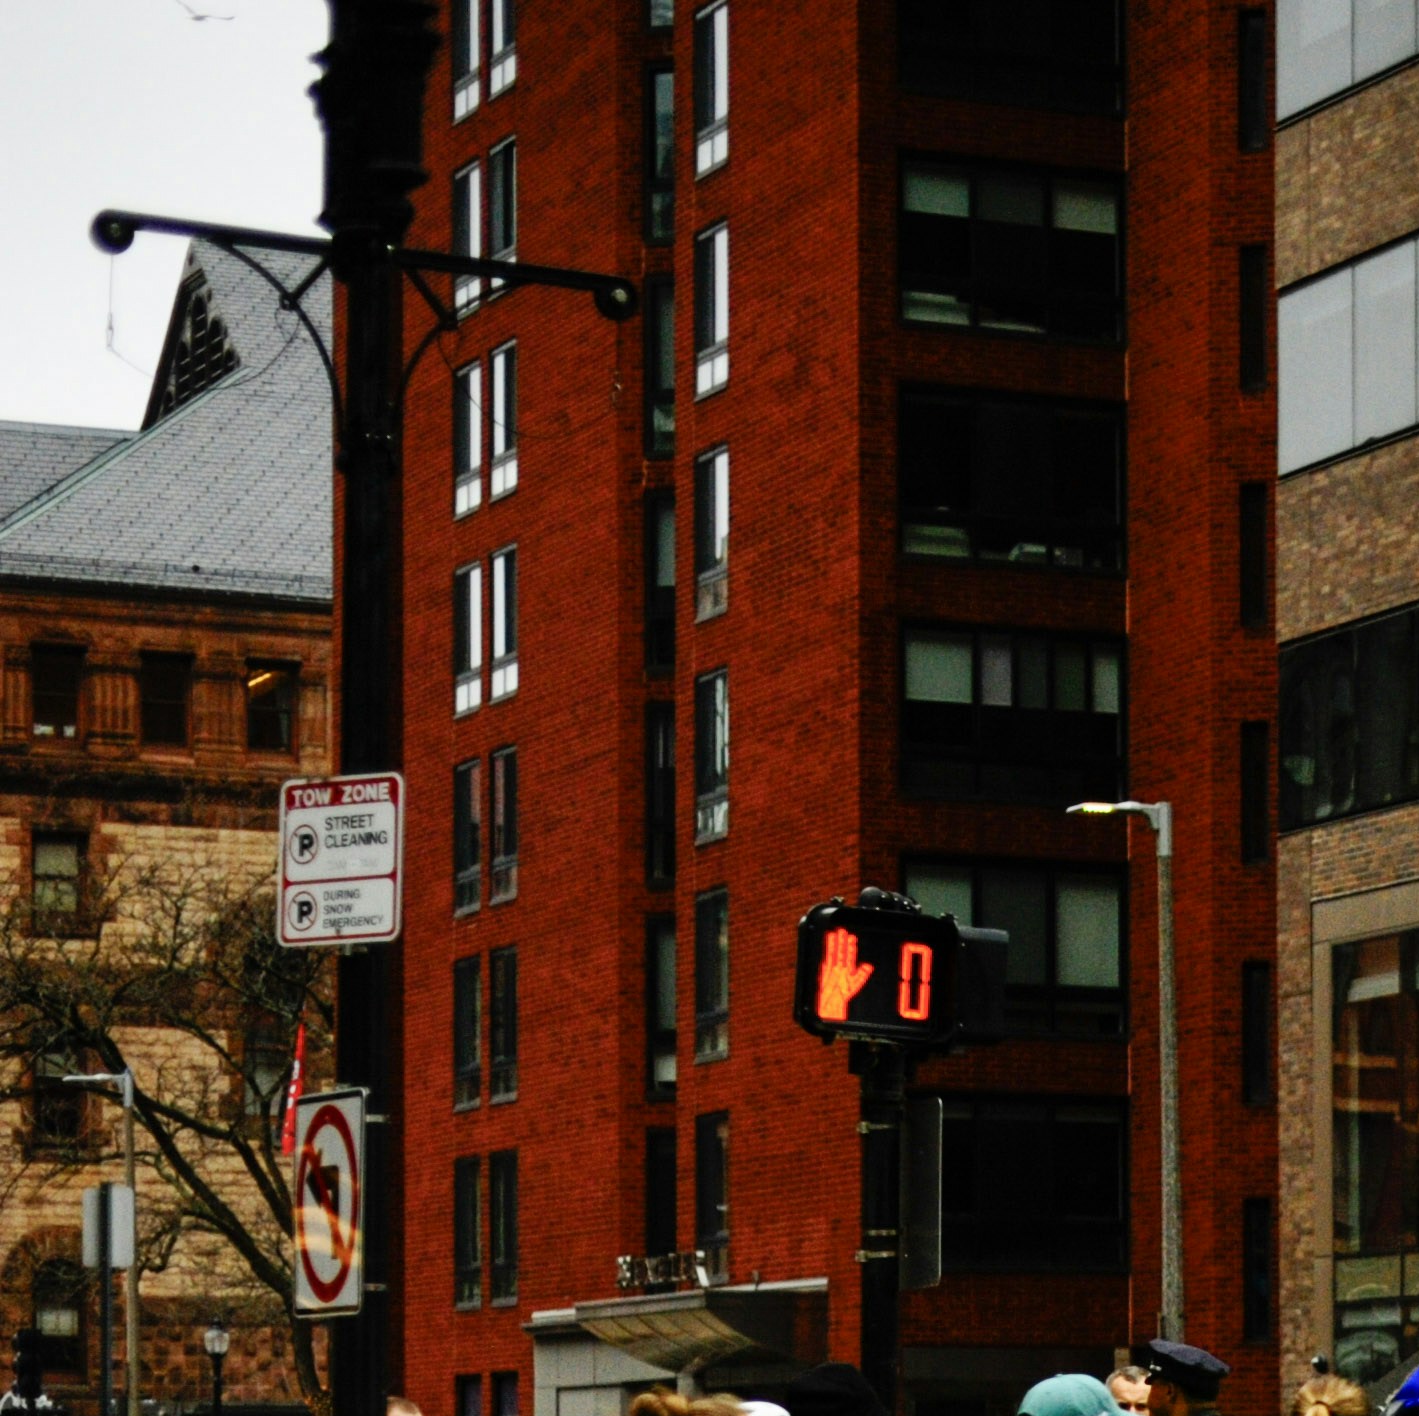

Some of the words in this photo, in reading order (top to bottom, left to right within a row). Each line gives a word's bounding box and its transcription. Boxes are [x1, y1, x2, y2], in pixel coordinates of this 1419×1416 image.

[292, 788, 331, 807] TOW
[341, 782, 390, 802] ZONE
[325, 814, 374, 831] STREET
[324, 831, 387, 849] CLEANING
[323, 889, 361, 901] DURING
[323, 904, 353, 914] SNOW
[323, 915, 383, 929] EMERGENCY
